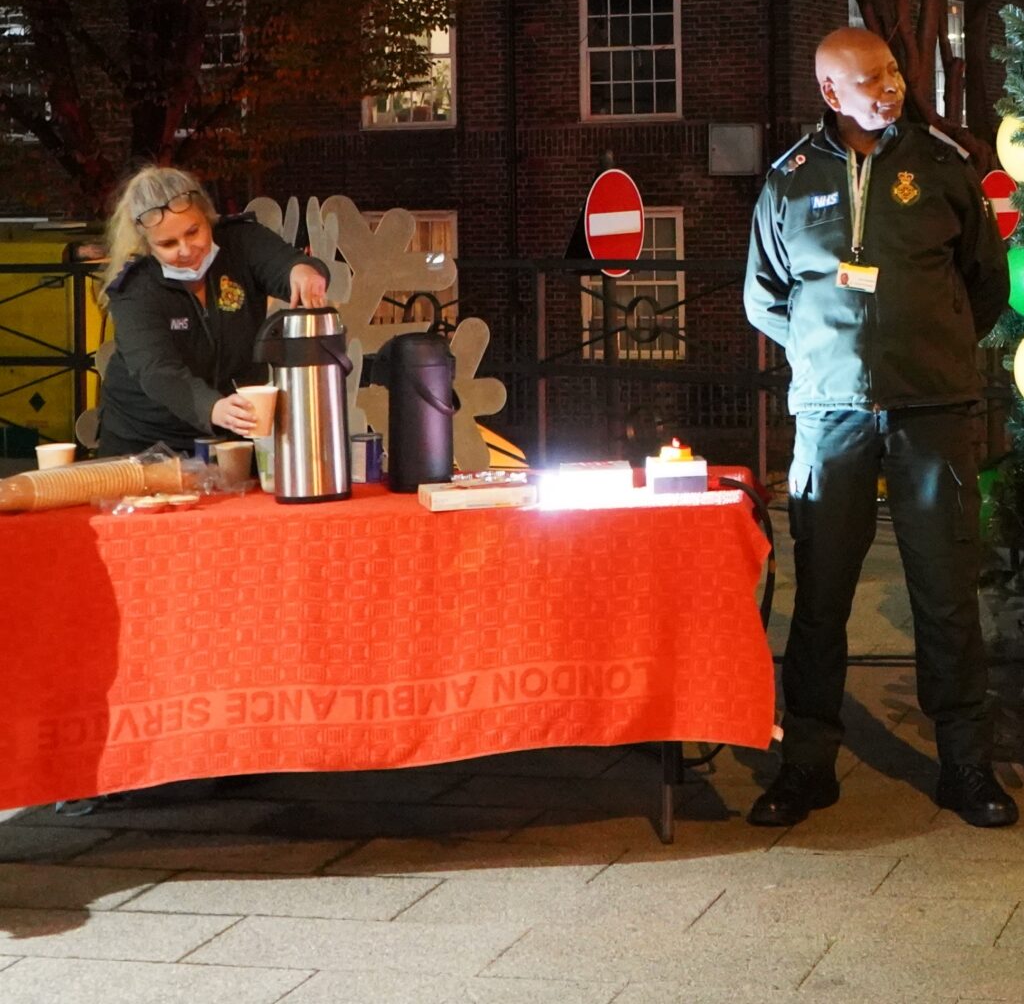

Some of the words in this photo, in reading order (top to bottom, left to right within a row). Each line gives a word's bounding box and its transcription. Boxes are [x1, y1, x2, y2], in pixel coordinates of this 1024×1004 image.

[813, 192, 839, 209] NHS
[170, 317, 189, 330] NHS
[226, 675, 477, 725] AMBULANCE
[493, 661, 650, 705] LONDON
[37, 696, 211, 751] SERVICE
